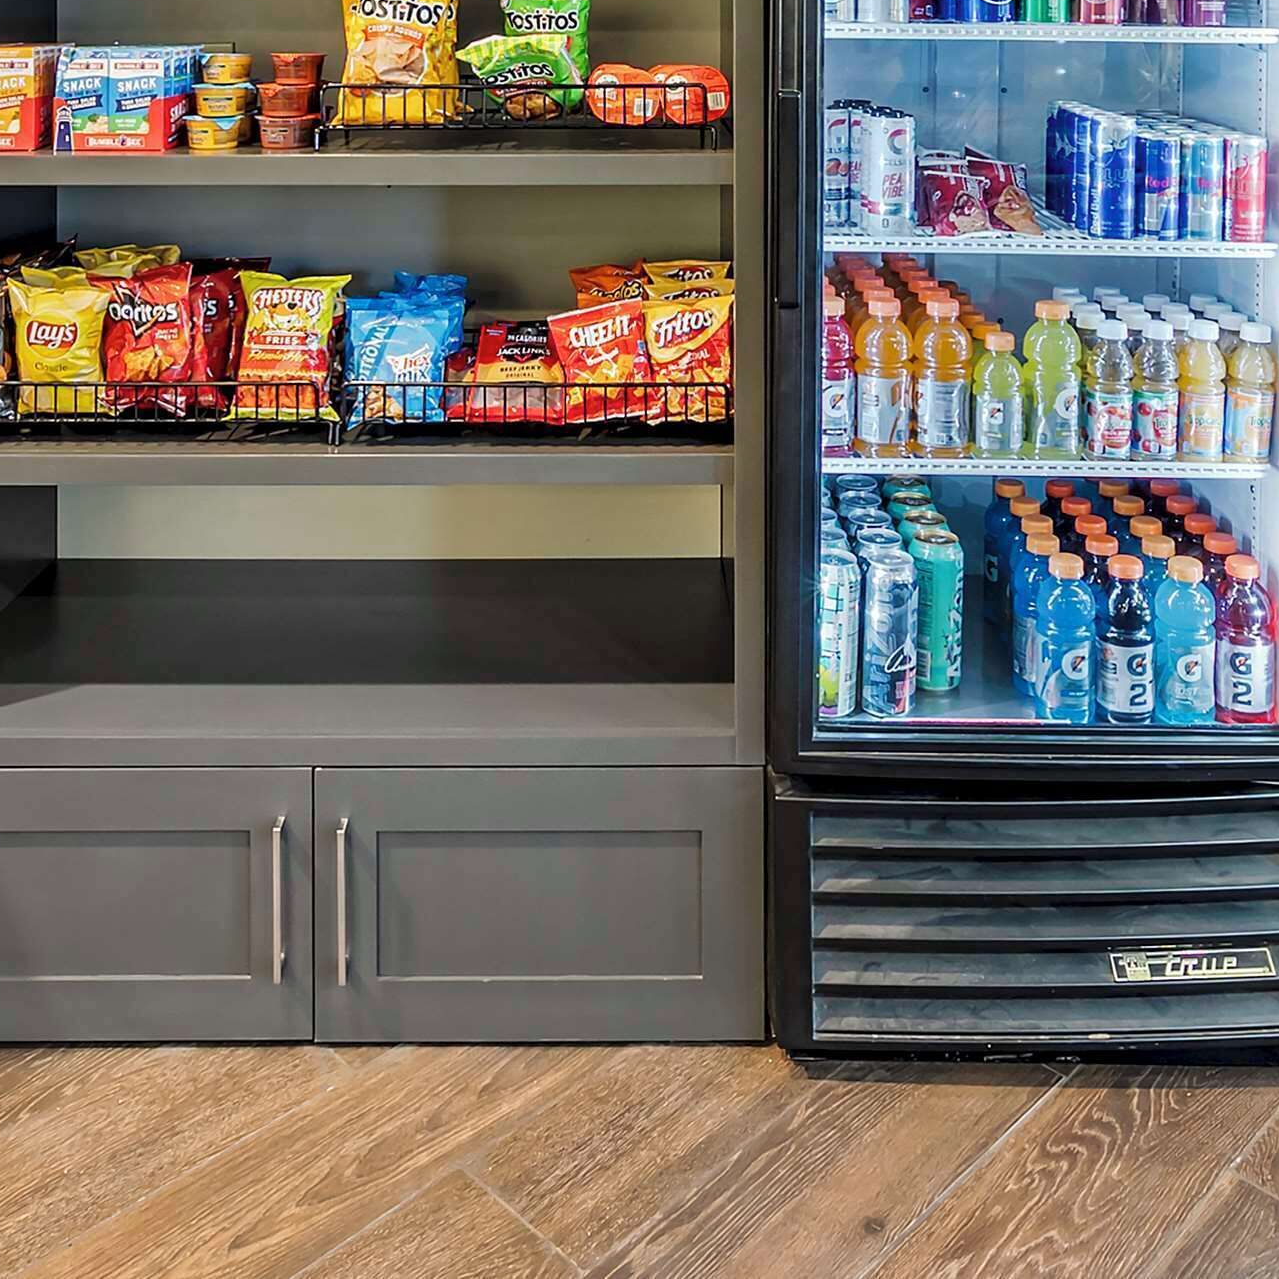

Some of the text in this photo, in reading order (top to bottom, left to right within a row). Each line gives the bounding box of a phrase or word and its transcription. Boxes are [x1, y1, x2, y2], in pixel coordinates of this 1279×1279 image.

[63, 78, 102, 92] SNACK
[117, 78, 157, 92] SNACK
[29, 322, 76, 349] Lay's
[652, 309, 713, 350] Fritos
[265, 336, 298, 345] FRIES
[496, 348, 521, 356] JACK
